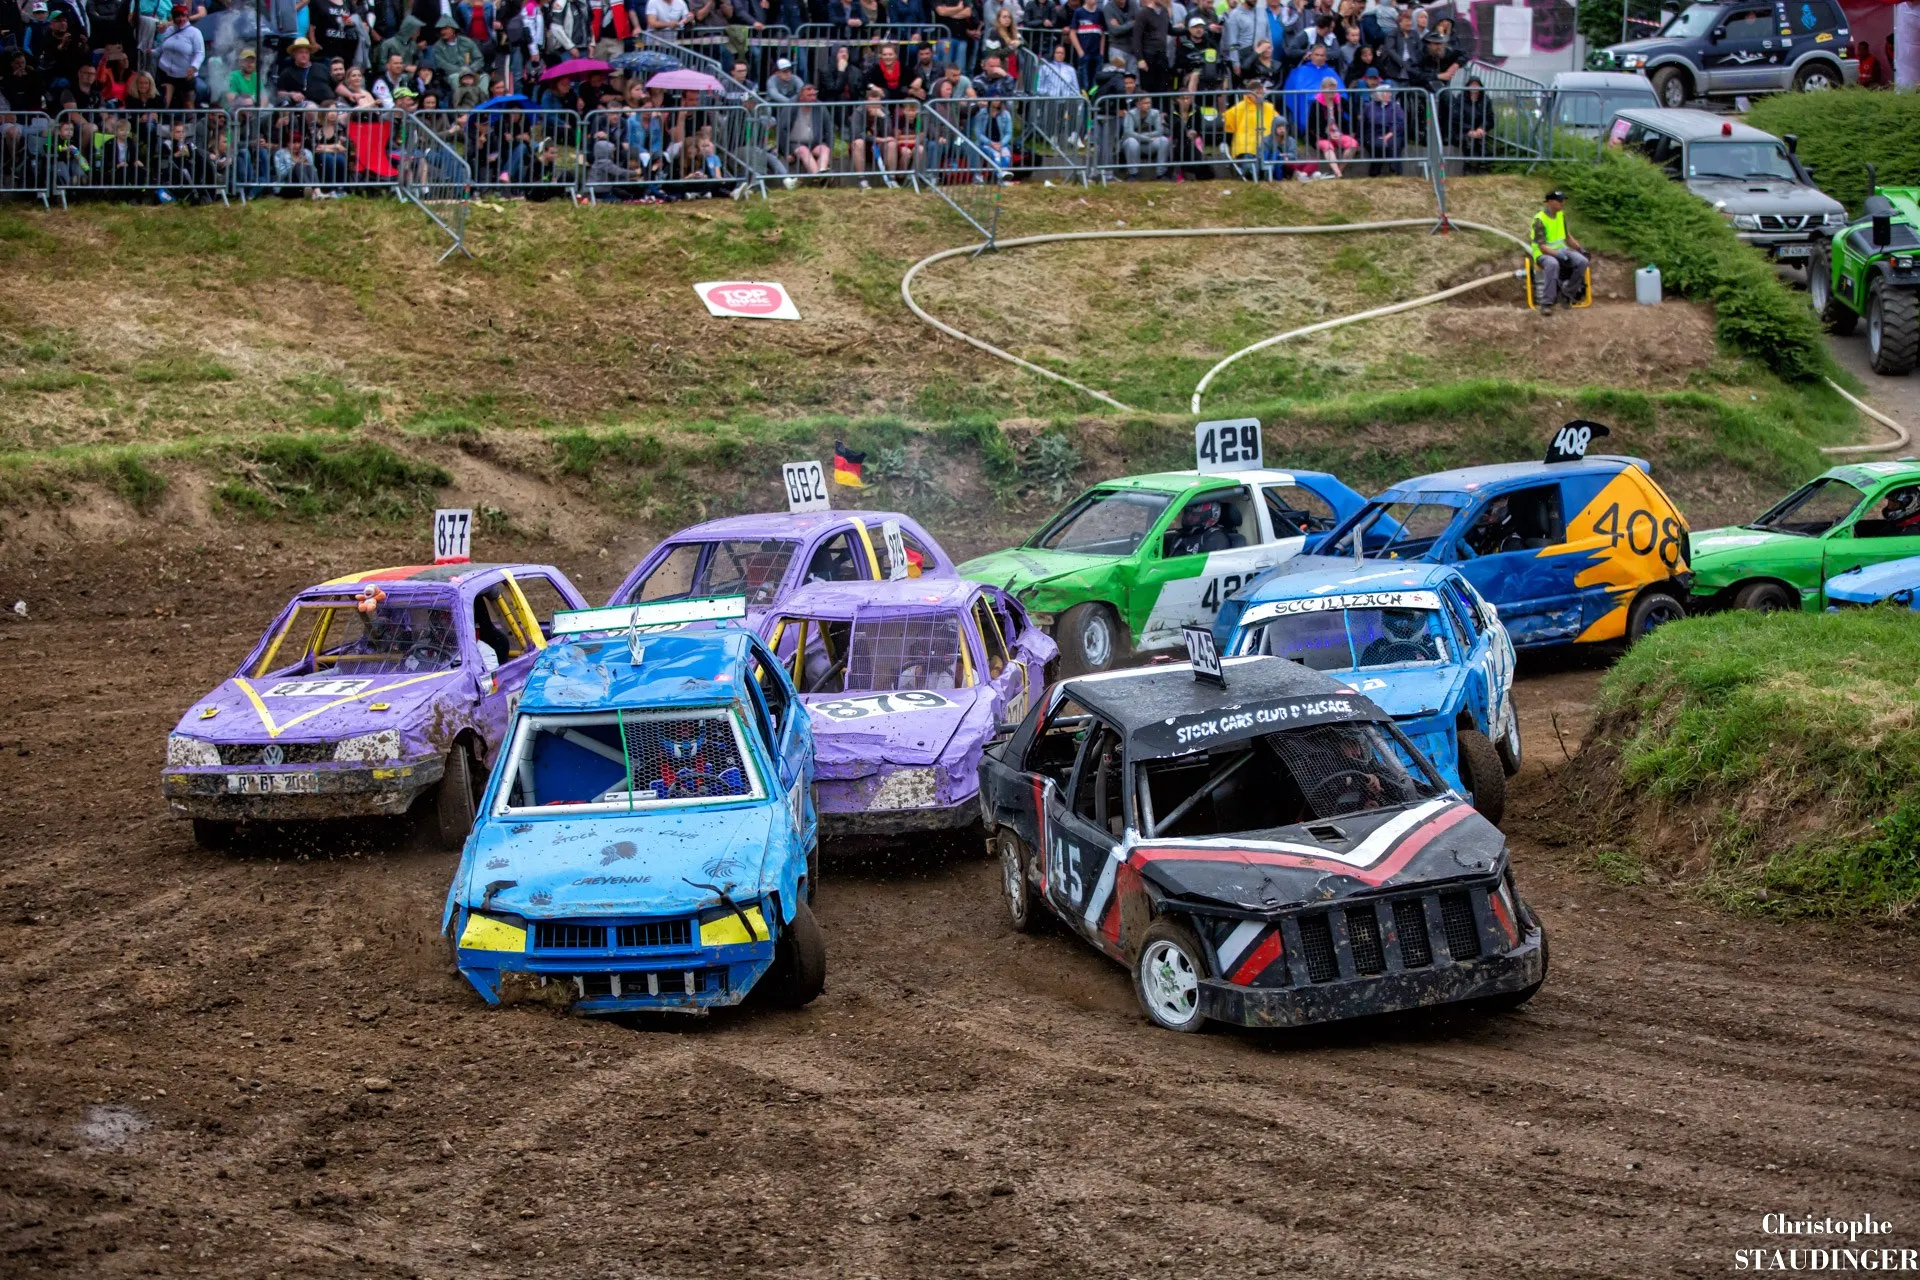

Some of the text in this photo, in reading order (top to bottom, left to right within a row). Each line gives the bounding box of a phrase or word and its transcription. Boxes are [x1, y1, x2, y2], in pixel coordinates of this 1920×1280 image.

[719, 289, 768, 302] TOP
[1200, 425, 1259, 464] 429
[1554, 426, 1592, 456] 408
[786, 465, 826, 503] 882
[438, 514, 469, 556] 877
[1592, 502, 1681, 570] 408
[1201, 572, 1261, 614] 42
[1275, 599, 1314, 614] SCC
[1186, 631, 1218, 671] 245
[273, 681, 366, 695] 877
[815, 690, 948, 719] 879
[1176, 719, 1219, 744] STOCK
[1220, 713, 1253, 732] CARS
[1256, 706, 1288, 724] CLUB
[552, 826, 700, 846] STOCK CAR CLUB
[571, 875, 654, 886] CHEYENNE
